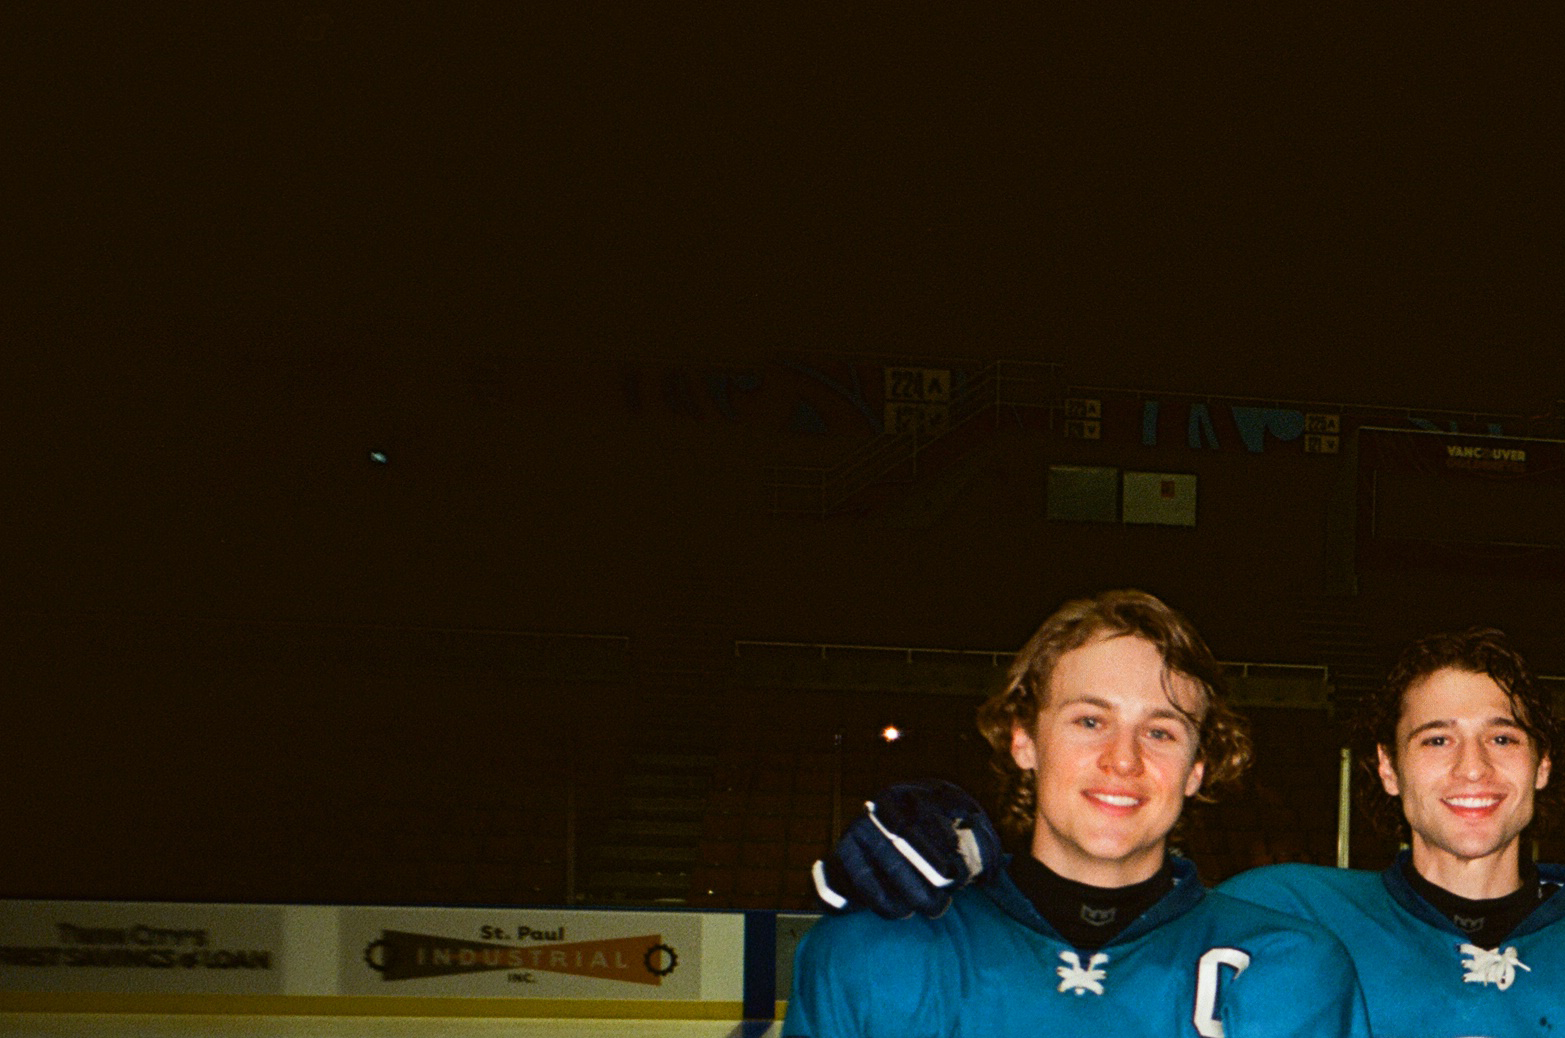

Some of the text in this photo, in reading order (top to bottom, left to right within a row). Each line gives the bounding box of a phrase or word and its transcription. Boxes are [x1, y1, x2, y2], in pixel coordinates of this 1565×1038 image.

[1447, 445, 1526, 461] VANCUVER
[480, 925, 564, 941] St. Paul
[416, 948, 629, 970] INDUSTRIAL
